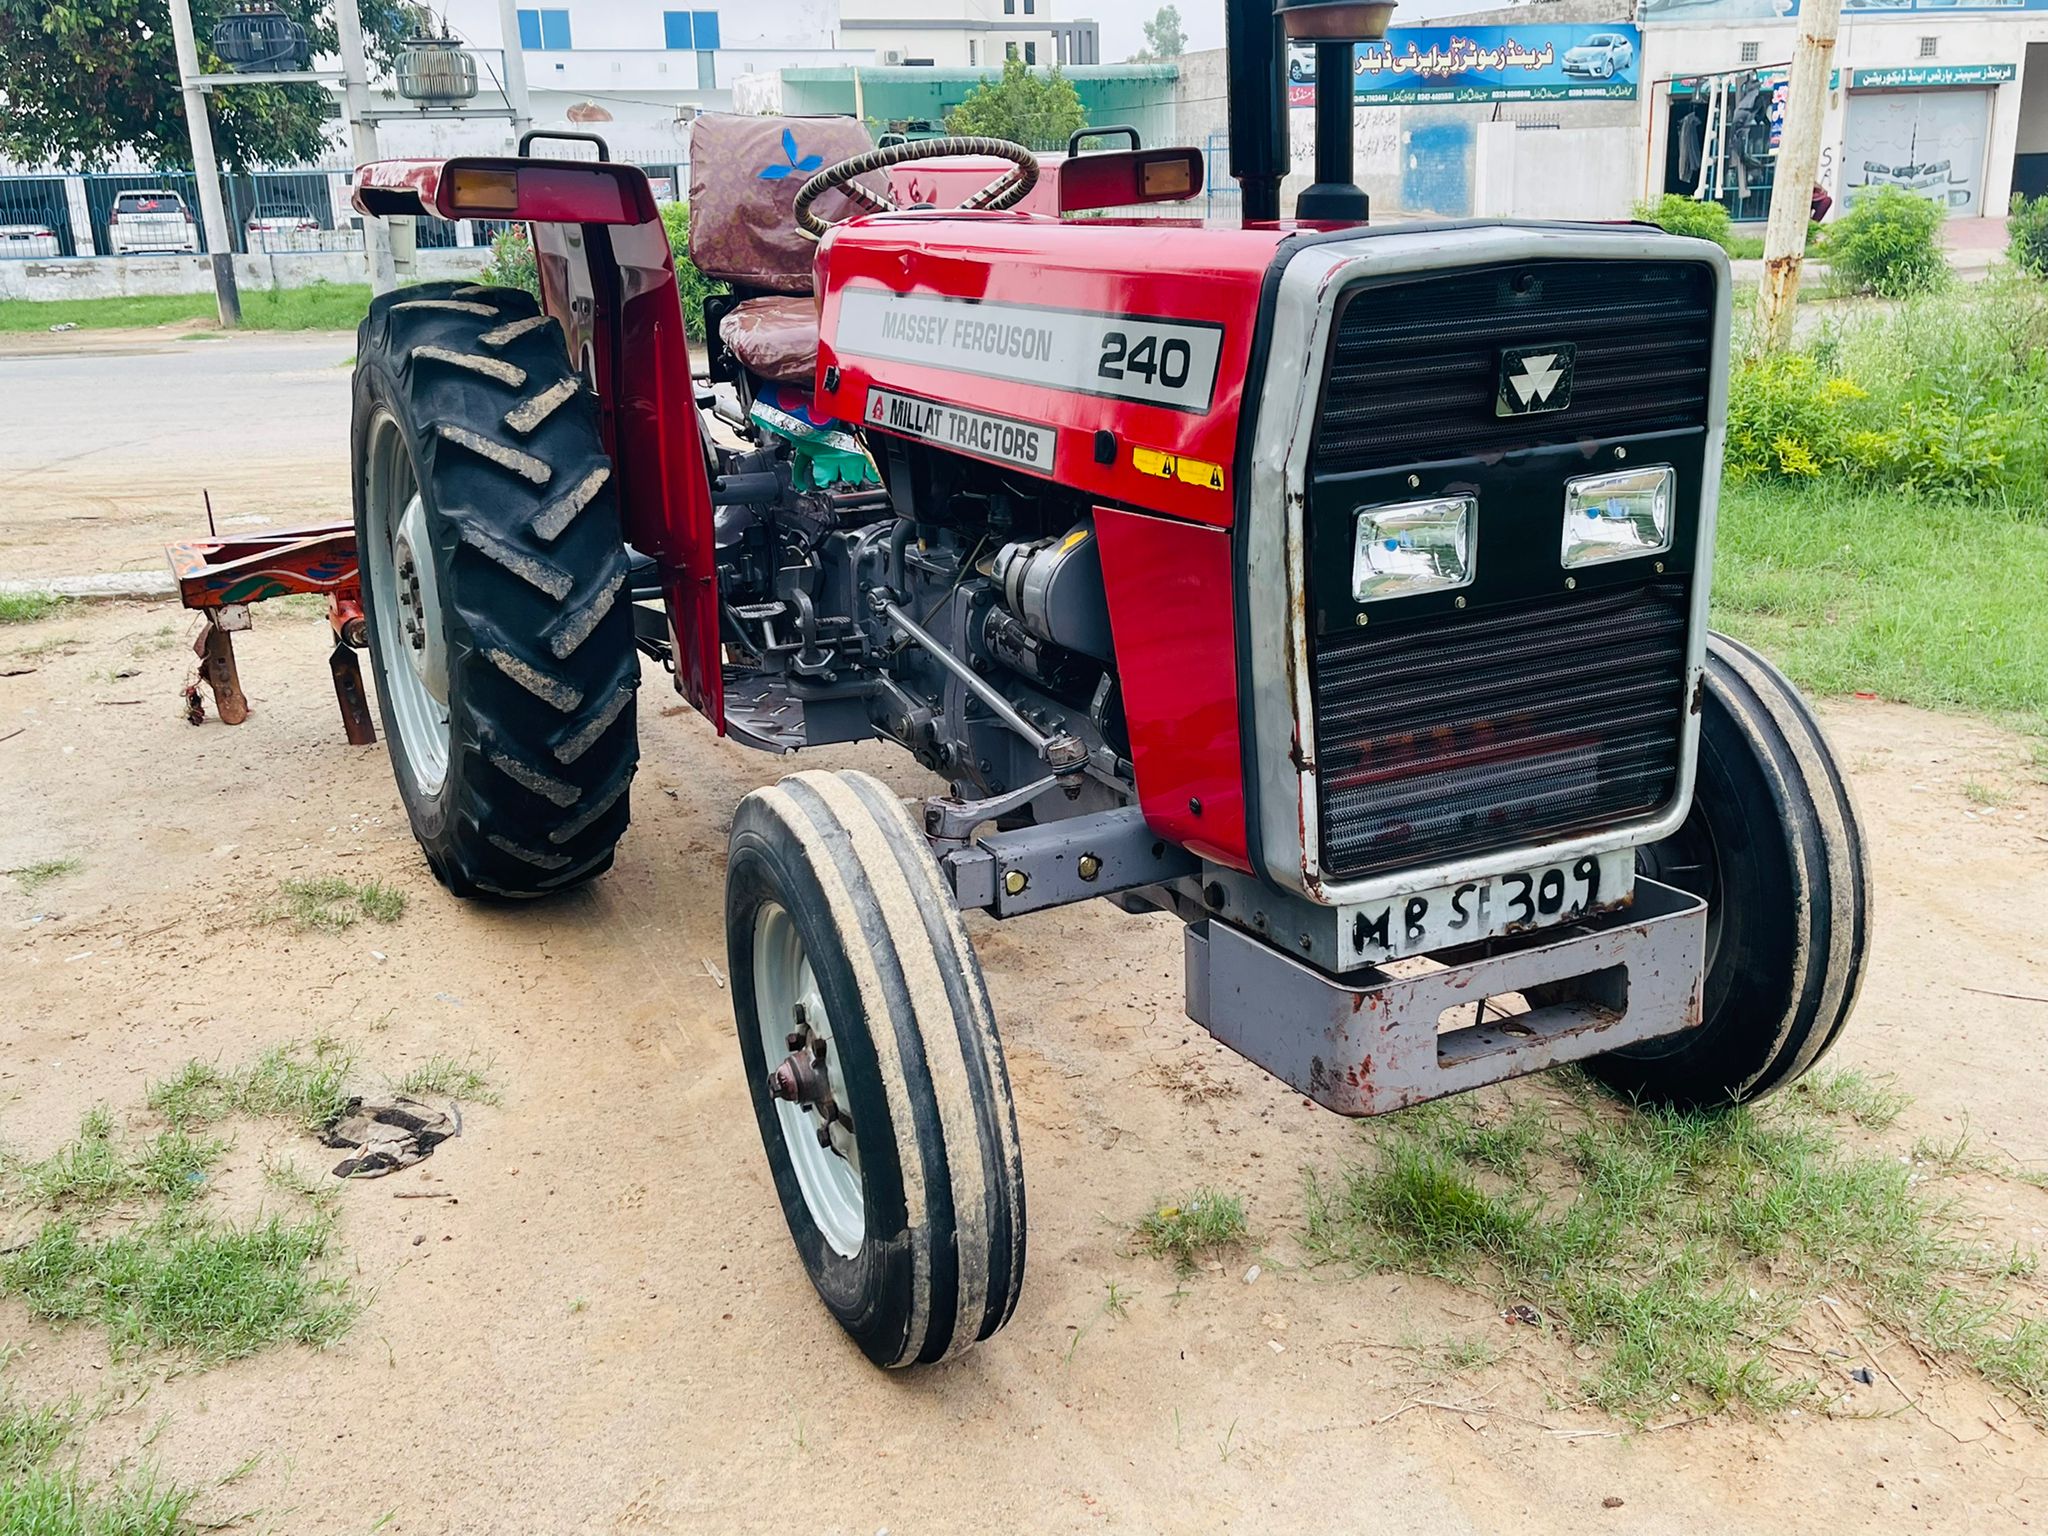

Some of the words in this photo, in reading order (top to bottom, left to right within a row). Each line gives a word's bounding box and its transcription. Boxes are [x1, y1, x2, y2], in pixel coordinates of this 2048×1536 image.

[881, 312, 950, 346] MASSEY
[952, 319, 1053, 362] FERGUSON
[1098, 331, 1191, 388] 240
[889, 398, 943, 437] MILLAT
[948, 412, 1039, 462] TRACTORS
